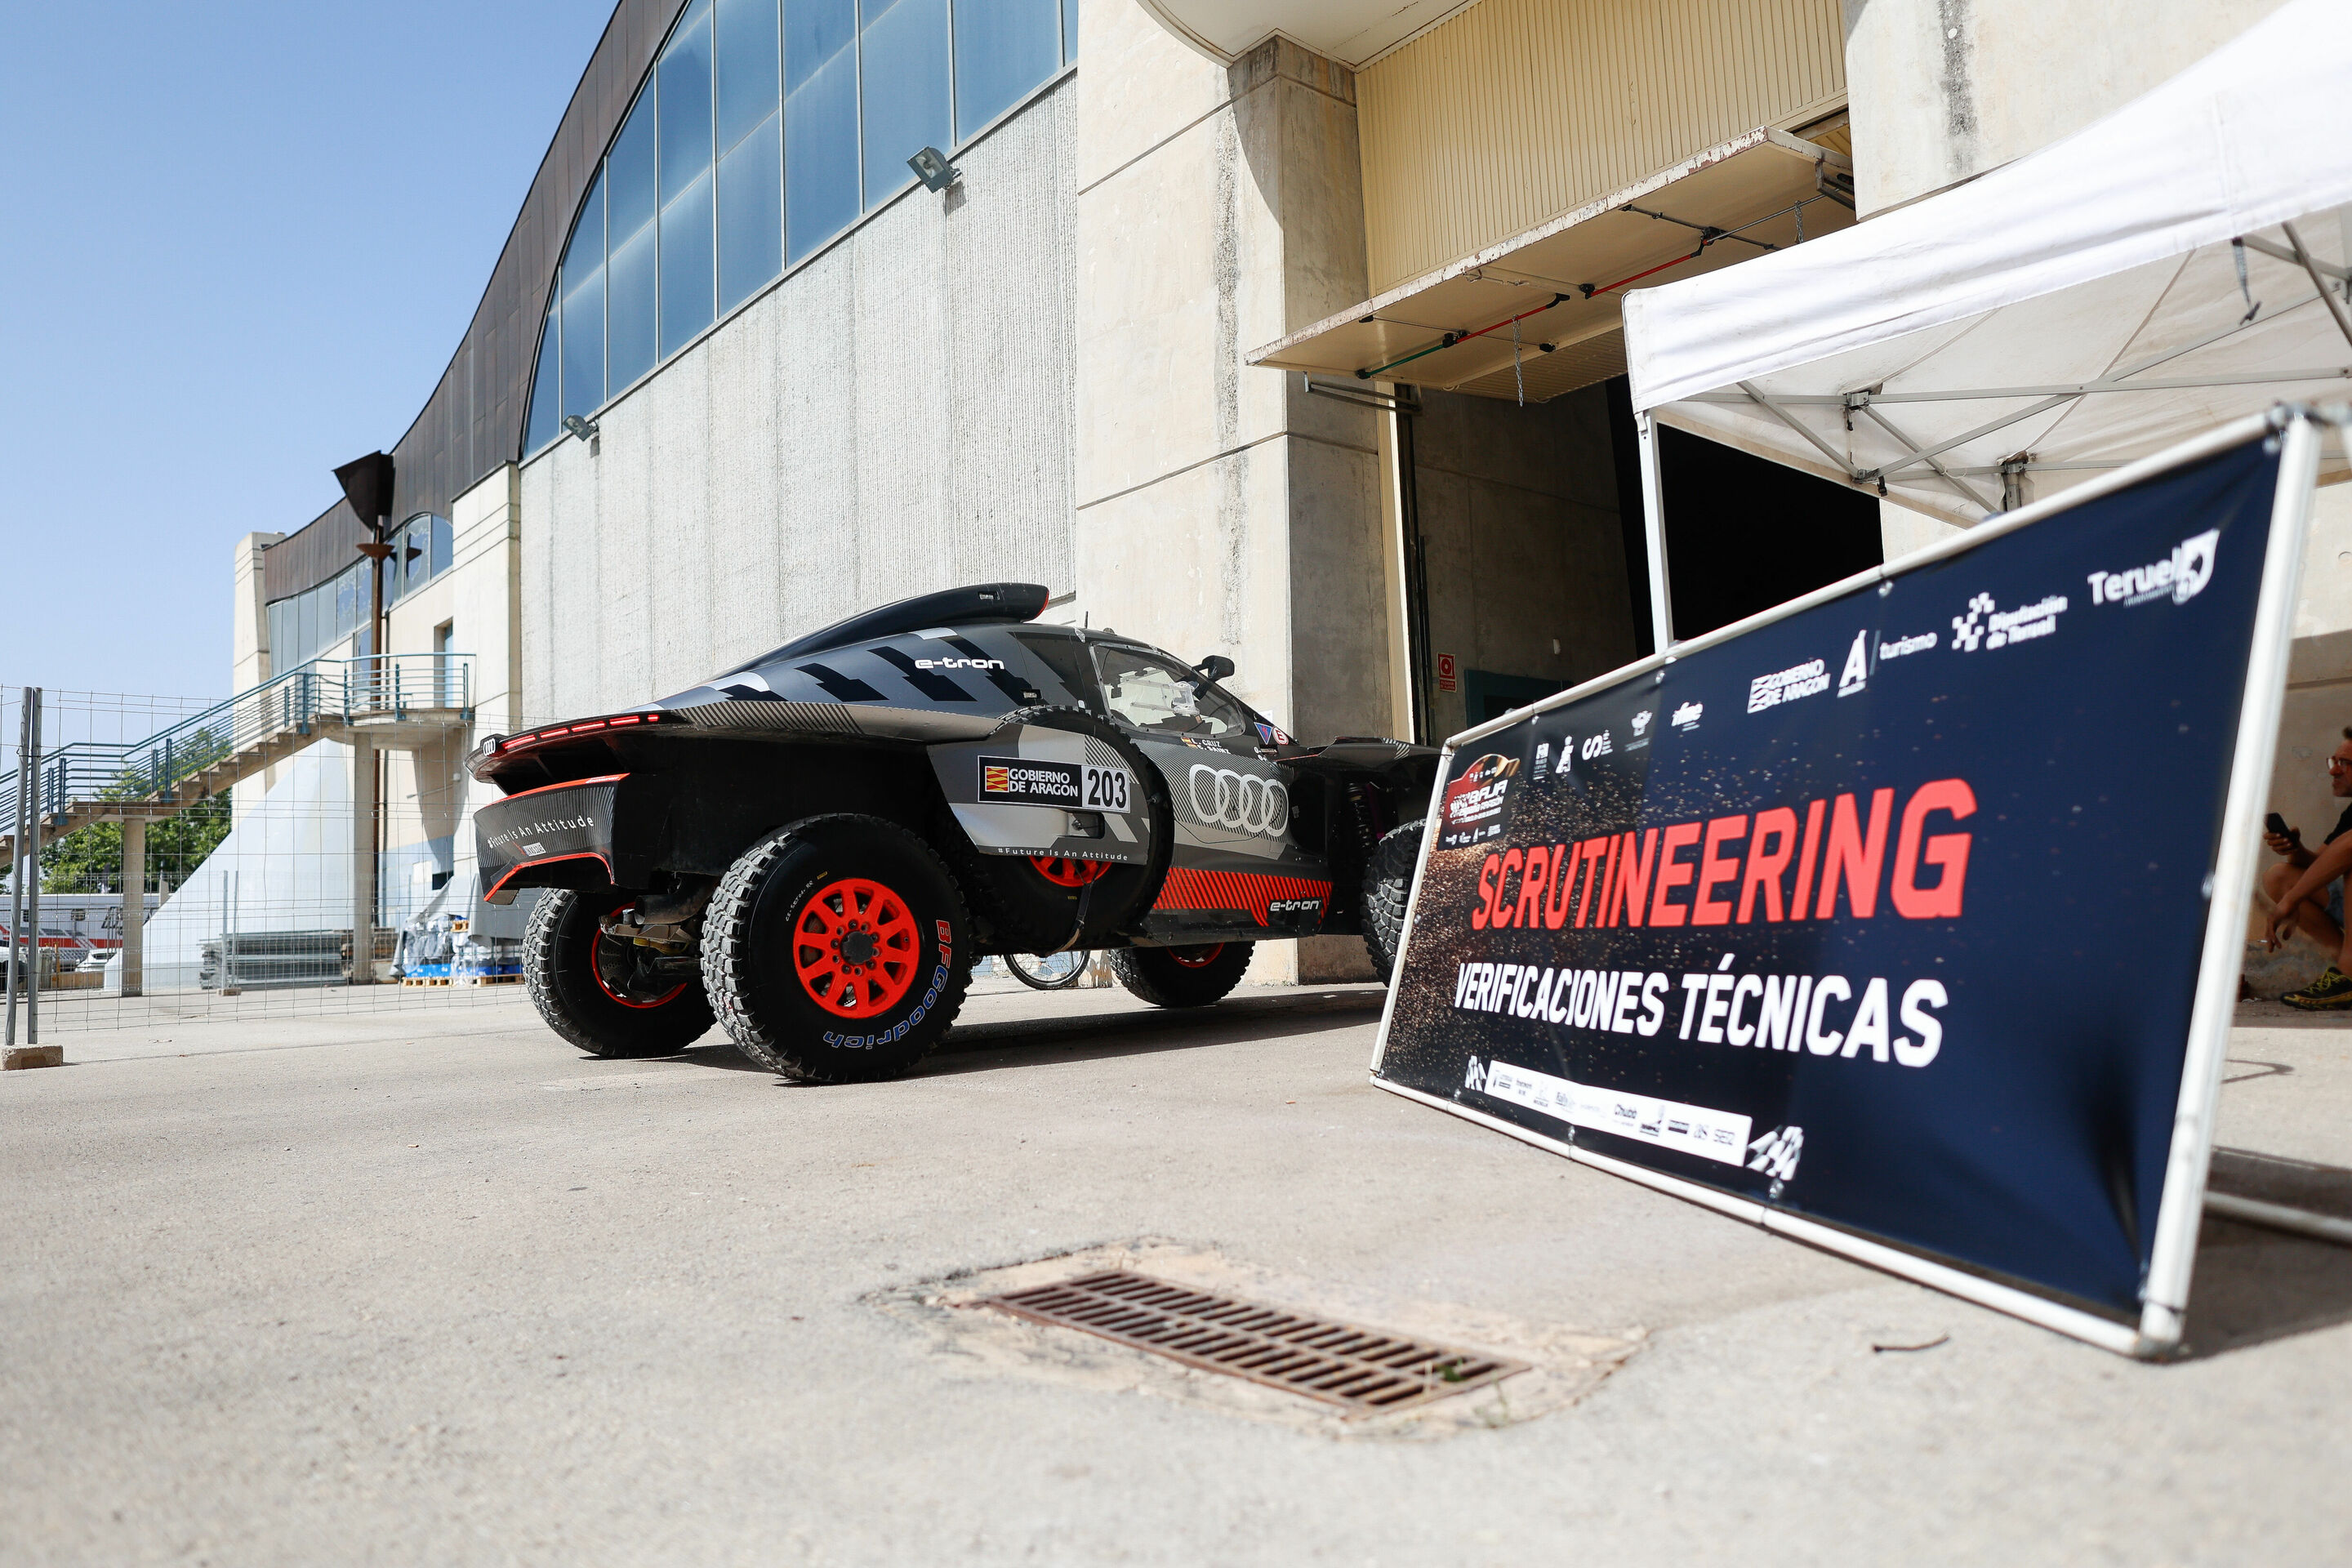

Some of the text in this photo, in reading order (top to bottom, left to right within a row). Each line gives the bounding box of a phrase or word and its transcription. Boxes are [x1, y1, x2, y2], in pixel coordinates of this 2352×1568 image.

[2087, 546, 2181, 606] Teruel
[914, 657, 1005, 670] e-tron
[1009, 768, 1071, 784] GOBIERNO
[1009, 780, 1079, 797] DE ARAGON
[1087, 768, 1127, 808] 203
[1468, 779, 1508, 804] BAJA
[518, 826, 533, 837] An
[535, 815, 595, 835] Attitude
[998, 847, 1045, 856] #Future
[1049, 849, 1059, 857] Is
[1082, 851, 1129, 861] Attitude
[1472, 777, 1977, 931] SCRUTINEERING
[1270, 899, 1320, 911] e-tron
[822, 919, 952, 1050] BFGoodrich
[1454, 952, 1949, 1068] VERIFICACIONES TÉCNICAS
